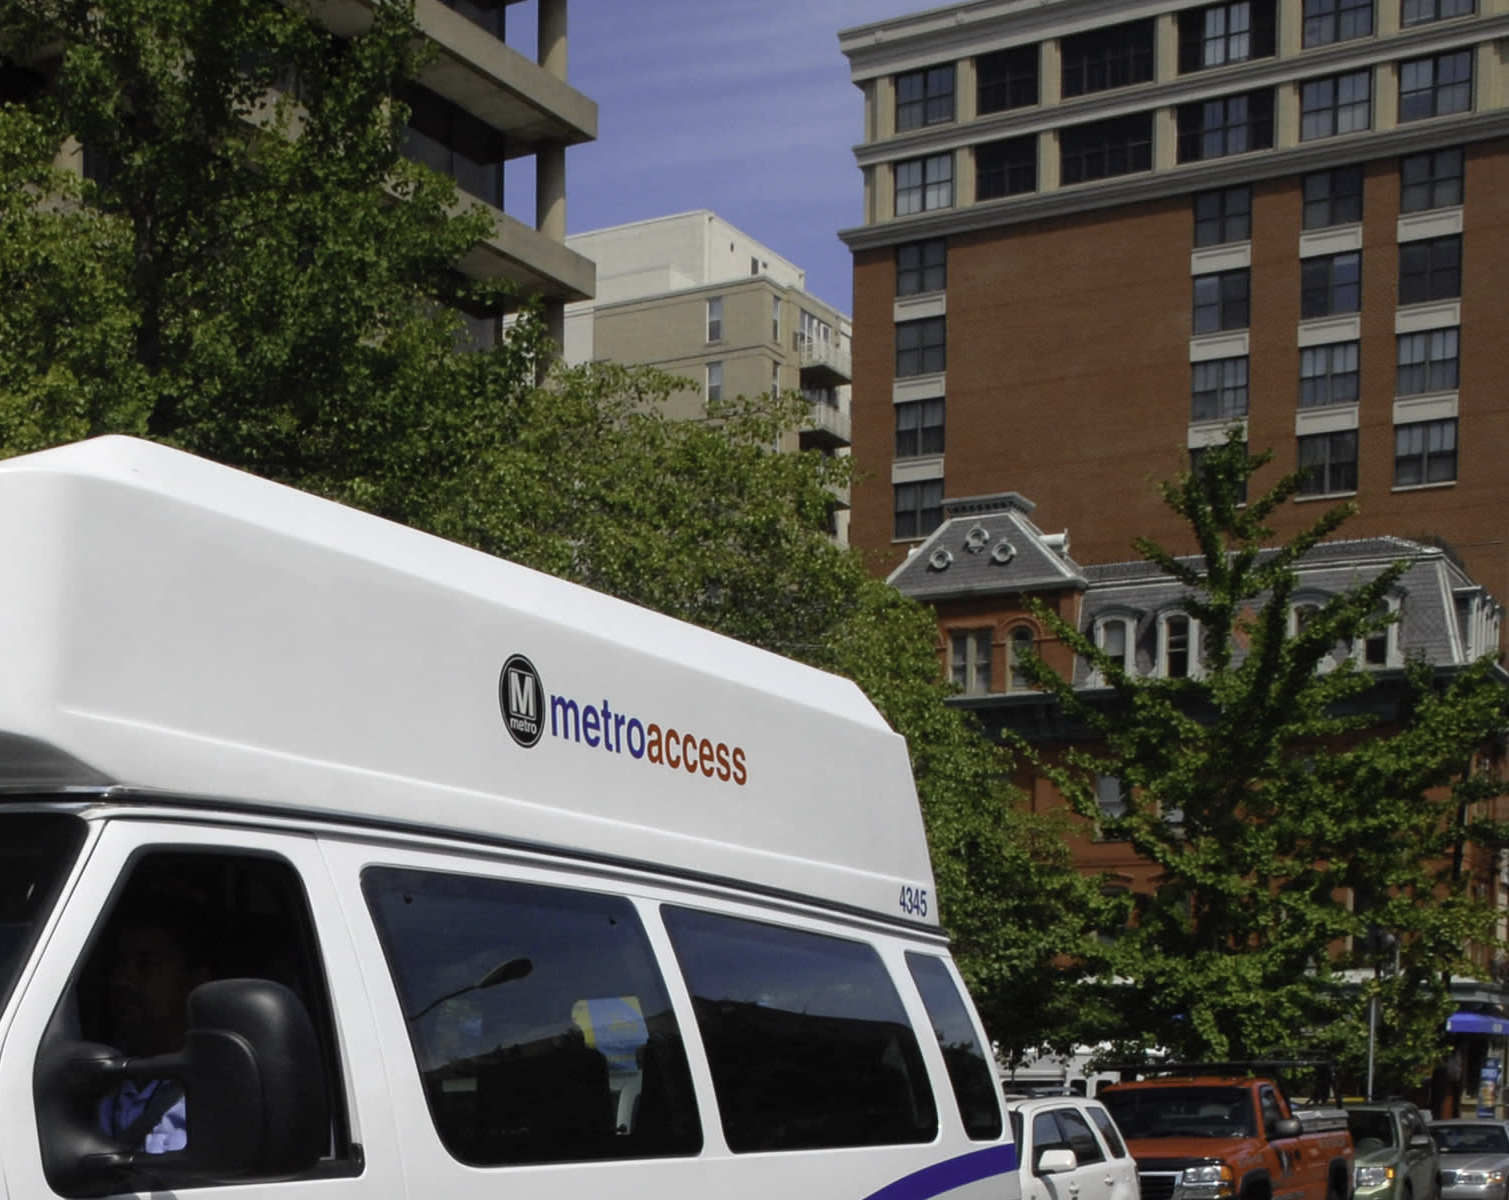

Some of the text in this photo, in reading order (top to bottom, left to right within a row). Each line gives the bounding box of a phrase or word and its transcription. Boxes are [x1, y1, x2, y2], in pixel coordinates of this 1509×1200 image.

[510, 718, 537, 734] metro
[550, 694, 747, 785] metroaccess
[899, 885, 927, 917] 4345
